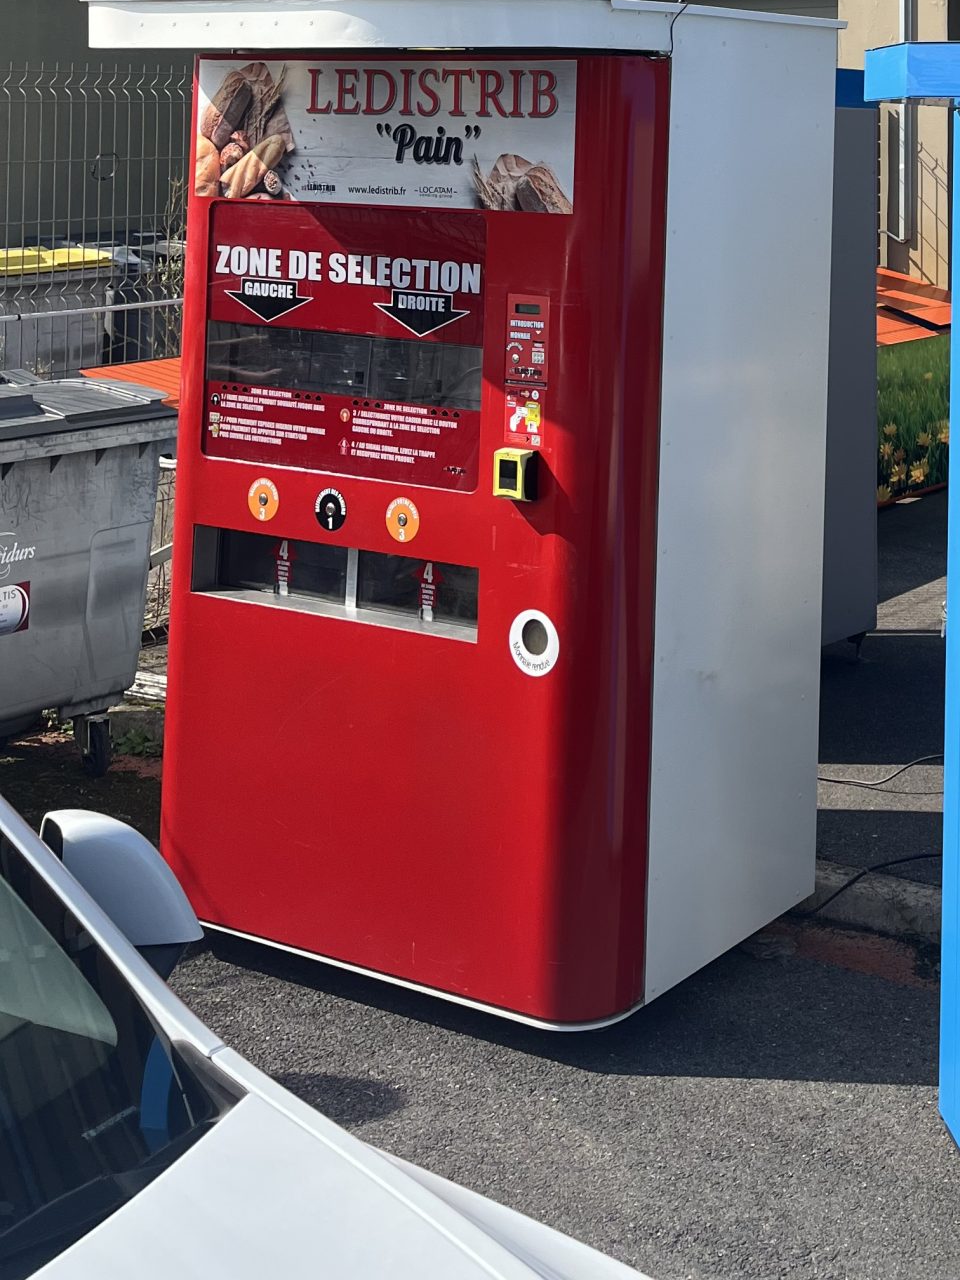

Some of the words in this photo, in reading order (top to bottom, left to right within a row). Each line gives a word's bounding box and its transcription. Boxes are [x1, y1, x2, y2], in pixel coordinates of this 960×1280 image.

[306, 68, 559, 118] LEDISTRIB
[348, 185, 406, 196] www.ledistrib.fr
[215, 245, 282, 278] ZONE
[289, 250, 322, 282] DE
[328, 252, 482, 294] SELECTION
[244, 280, 294, 299] GAUCHE
[397, 294, 446, 313] DROITE
[259, 508, 266, 520] 3
[327, 517, 333, 529] 1
[399, 528, 405, 541] 3
[279, 540, 288, 560] 4
[423, 562, 433, 583] 4
